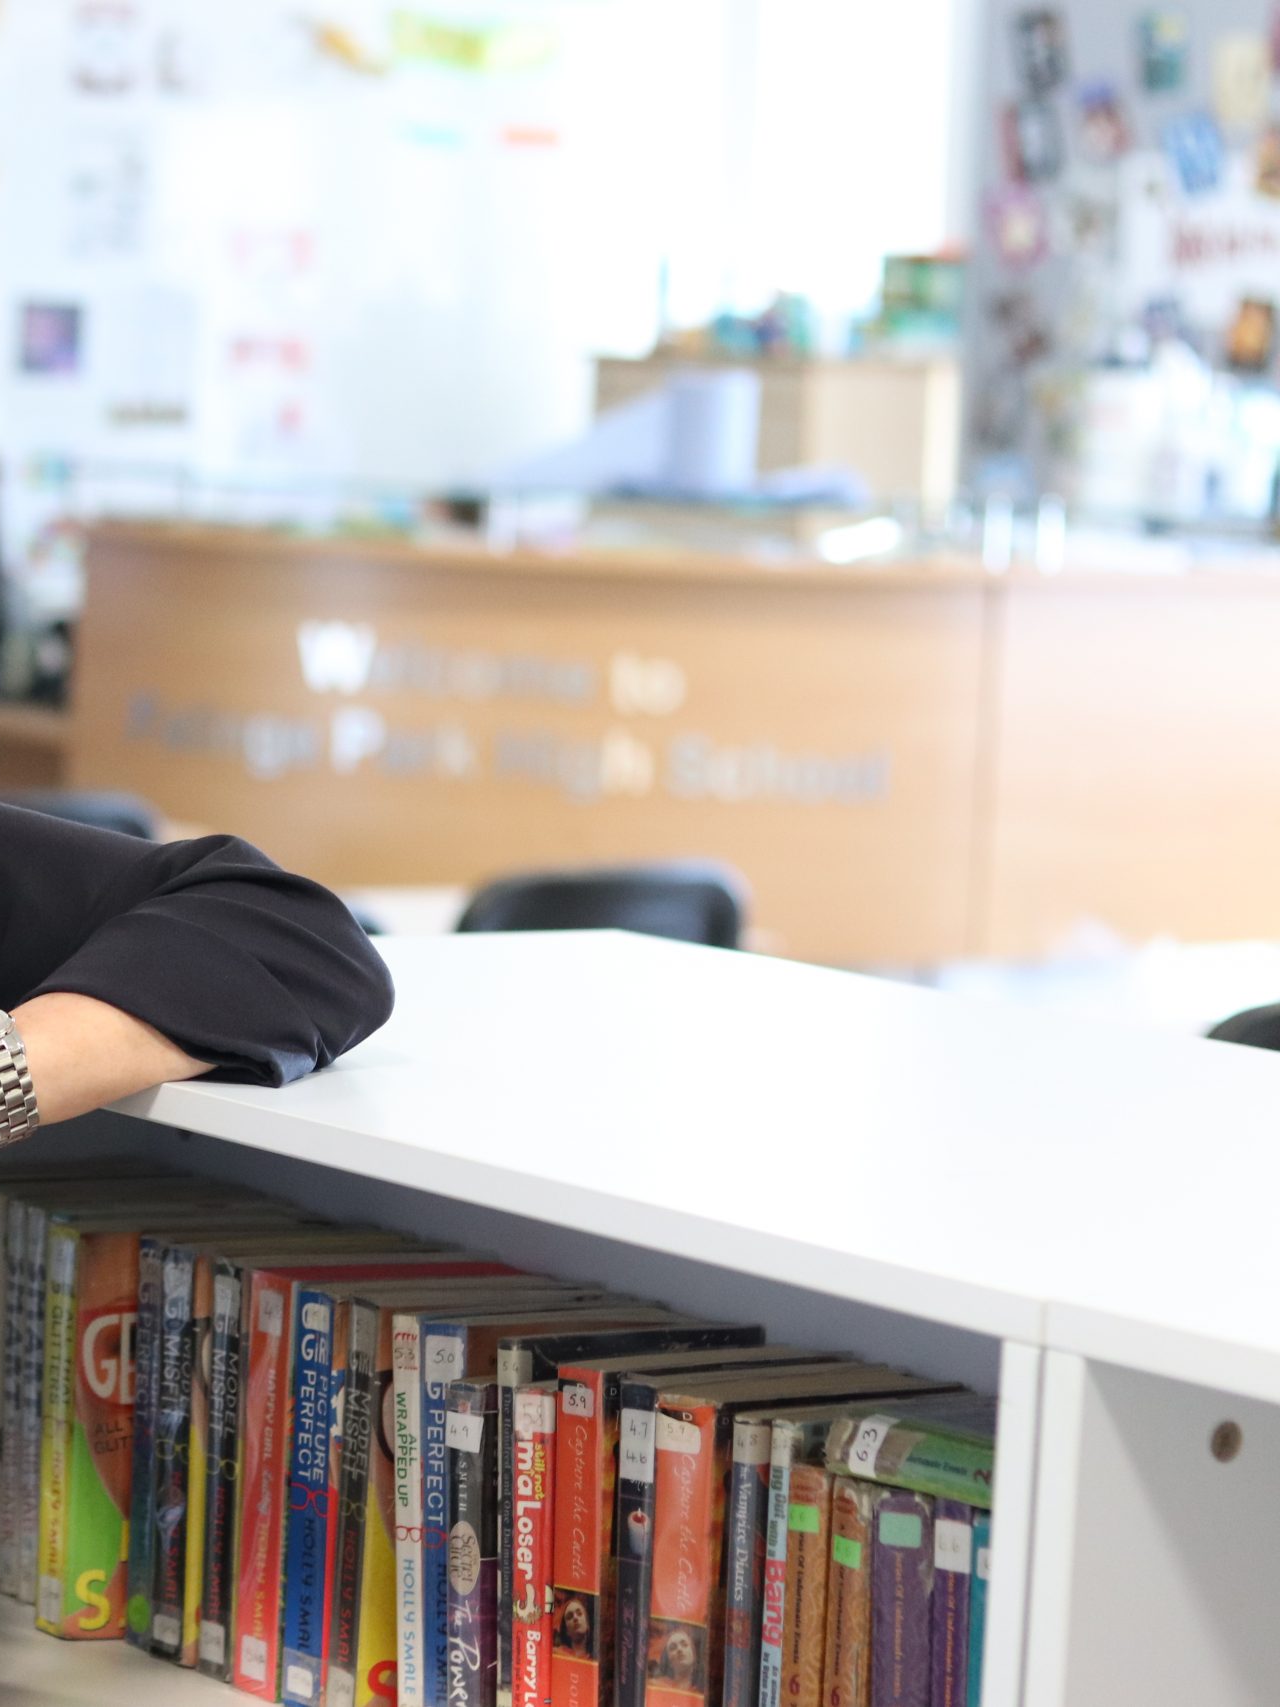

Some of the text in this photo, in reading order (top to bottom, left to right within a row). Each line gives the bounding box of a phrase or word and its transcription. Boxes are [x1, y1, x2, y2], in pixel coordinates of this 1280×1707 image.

[223, 1352, 240, 1439] MODEL
[298, 1369, 317, 1483] PERFECT
[312, 1375, 328, 1484] PICTURE
[355, 1391, 372, 1476] MODEL
[396, 1391, 409, 1508] WRAPPED UP
[408, 1433, 418, 1467] ALL
[426, 1409, 446, 1527] PERFECT
[458, 1459, 468, 1512] SMITH
[534, 1442, 546, 1501] still not
[301, 1517, 316, 1588] HOLLY
[516, 1500, 542, 1581] Loser
[736, 1482, 753, 1543] Vampire
[340, 1530, 356, 1601] HOLLY
[734, 1548, 749, 1602] Diaries
[761, 1559, 787, 1649] Bang
[403, 1558, 416, 1696] HOLLY SMALE
[523, 1629, 542, 1688] Barry
